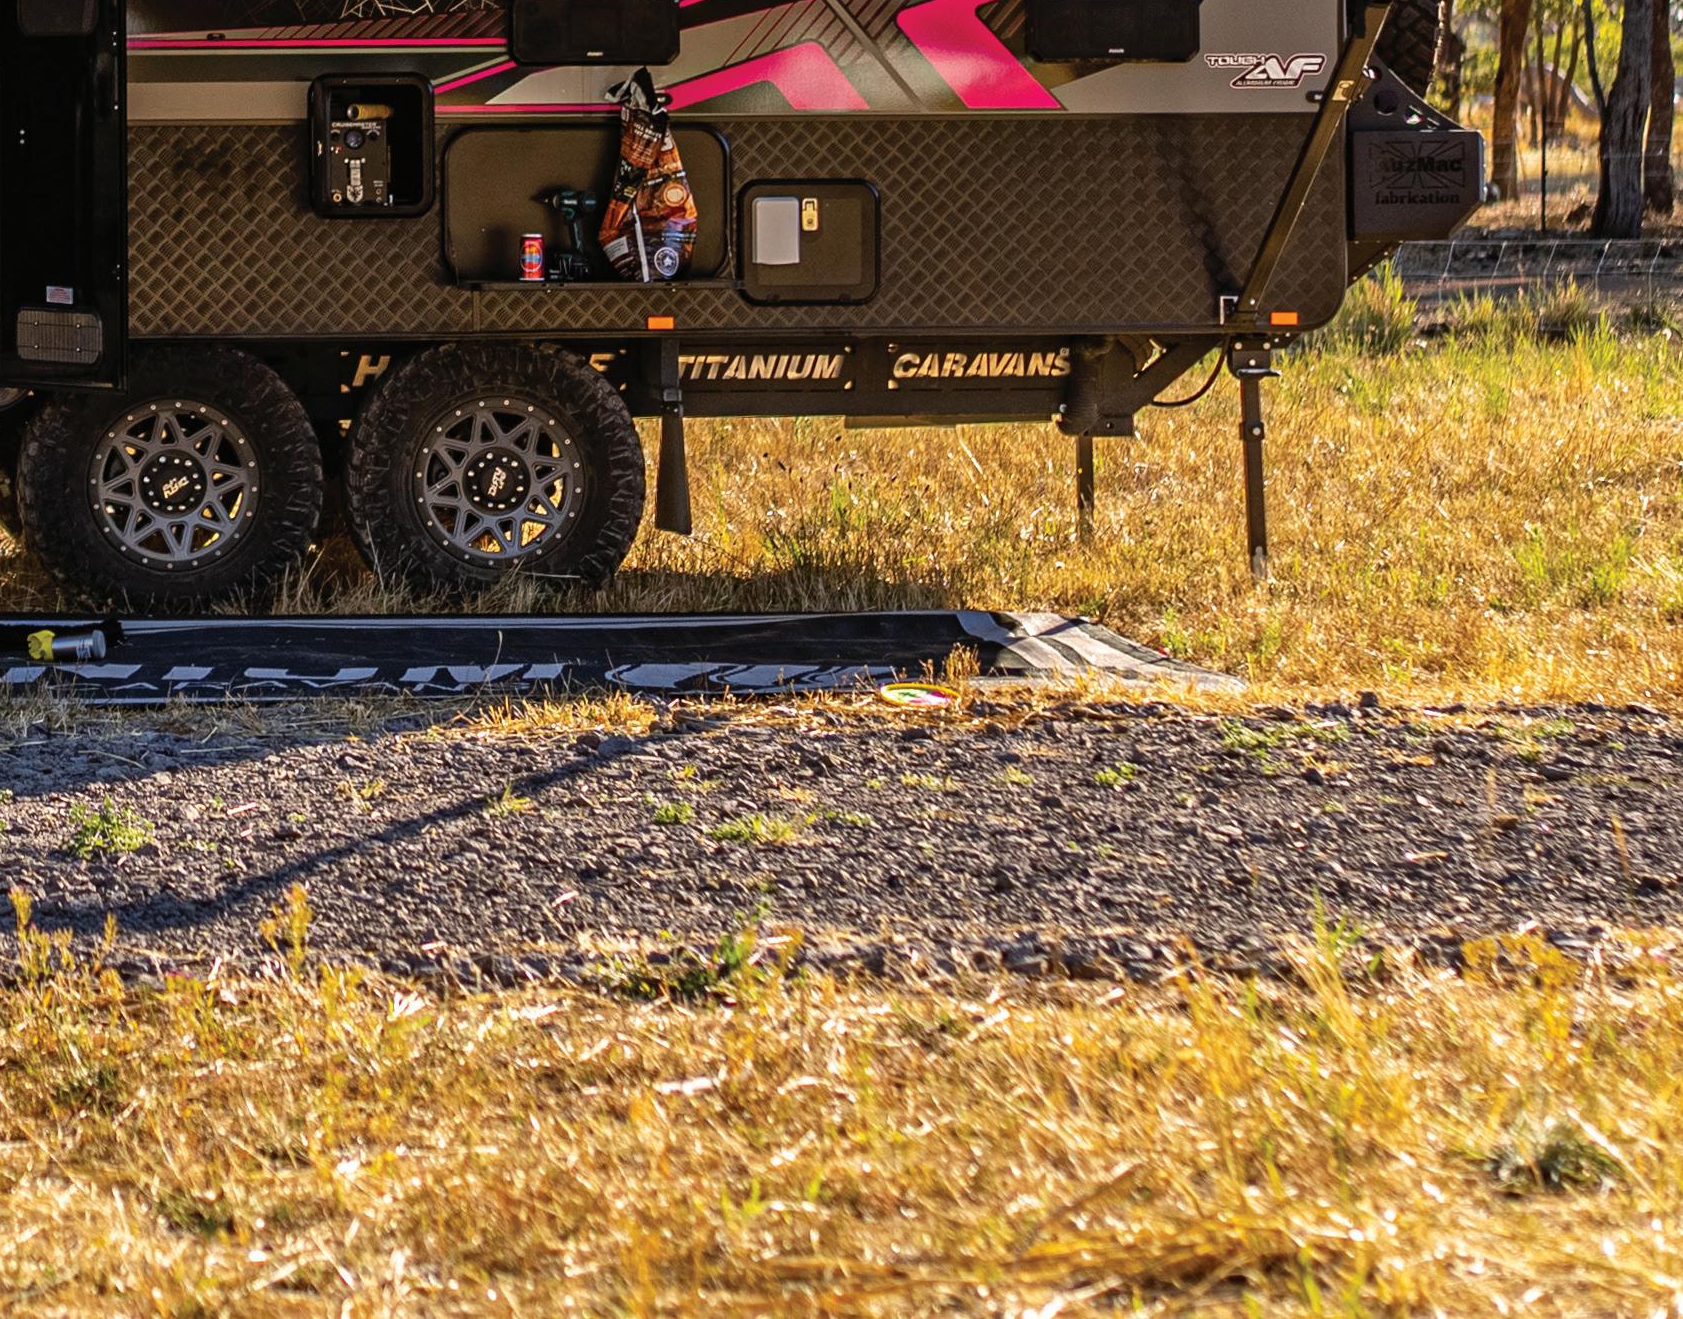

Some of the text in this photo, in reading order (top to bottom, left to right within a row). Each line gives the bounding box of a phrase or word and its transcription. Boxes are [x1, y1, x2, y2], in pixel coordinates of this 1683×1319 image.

[1206, 56, 1265, 66] TOUGH
[1375, 190, 1461, 204] fabrication
[678, 352, 1072, 380] TITANIUM CARAVANS
